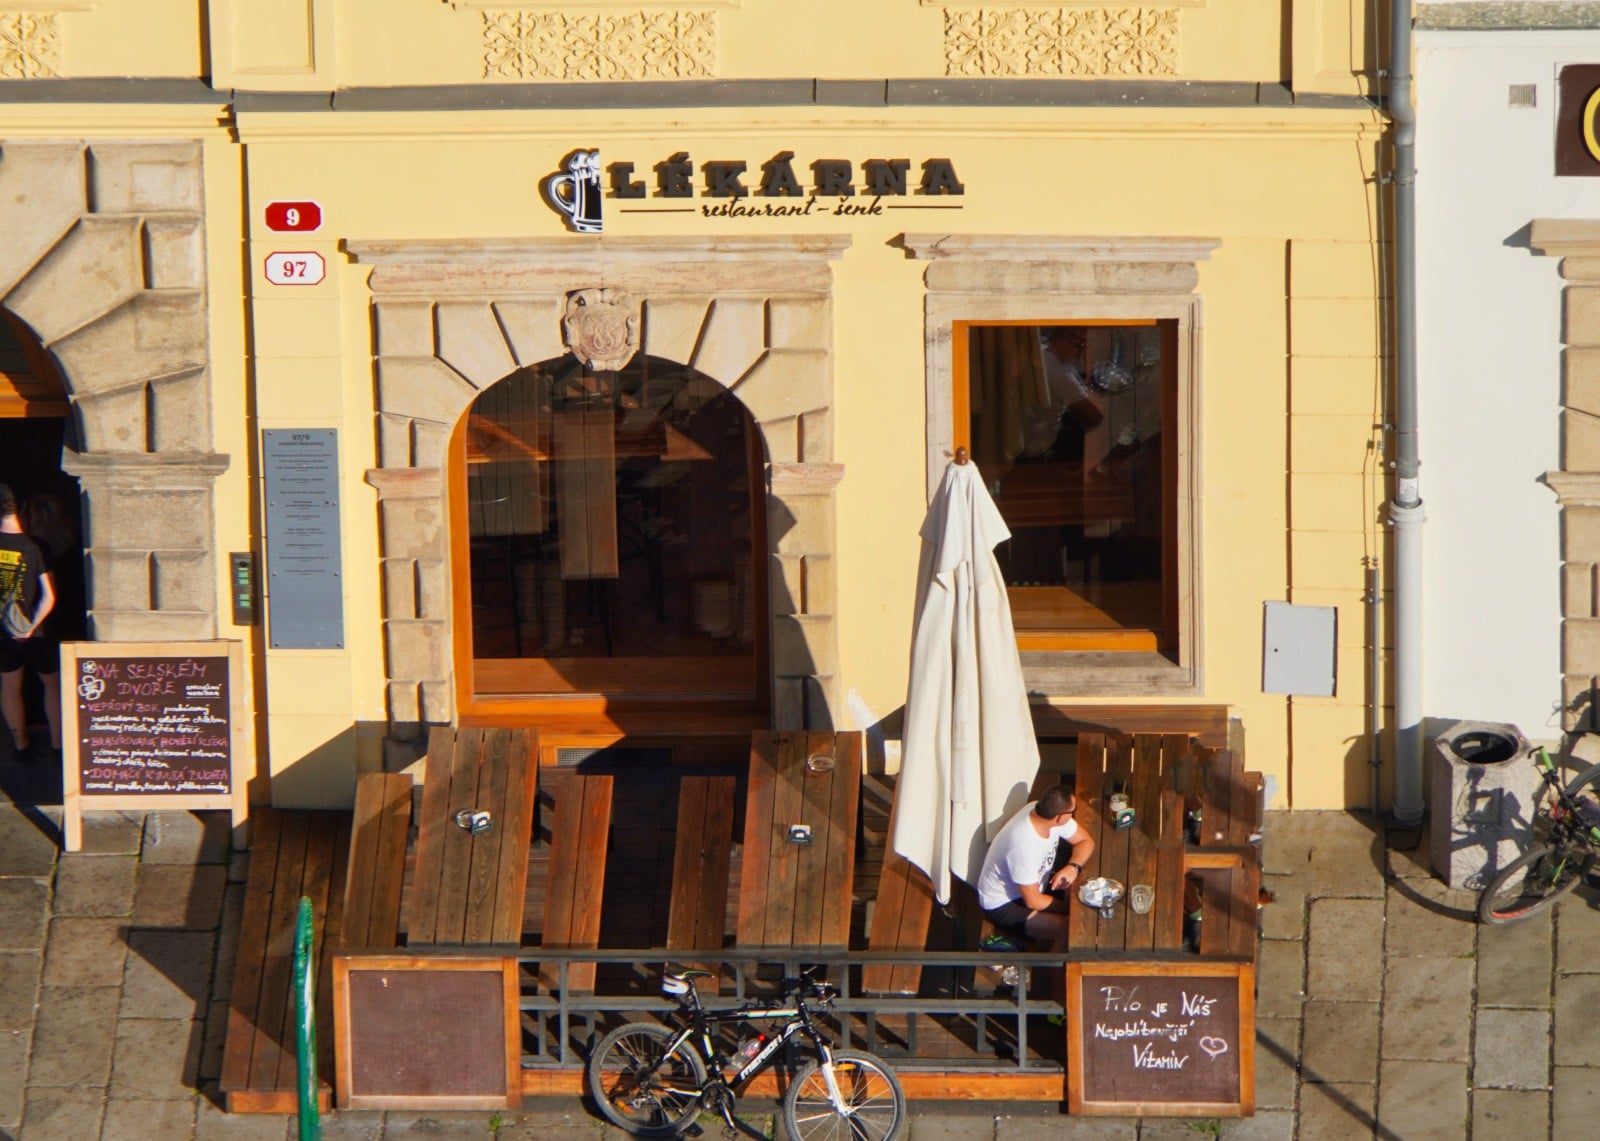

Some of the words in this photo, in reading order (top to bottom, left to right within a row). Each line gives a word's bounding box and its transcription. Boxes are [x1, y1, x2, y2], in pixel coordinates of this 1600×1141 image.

[605, 151, 965, 198] LÉKÁRNA
[701, 195, 818, 217] restaurant
[833, 195, 883, 215] šenk
[285, 208, 300, 226] 9
[282, 261, 307, 277] 97
